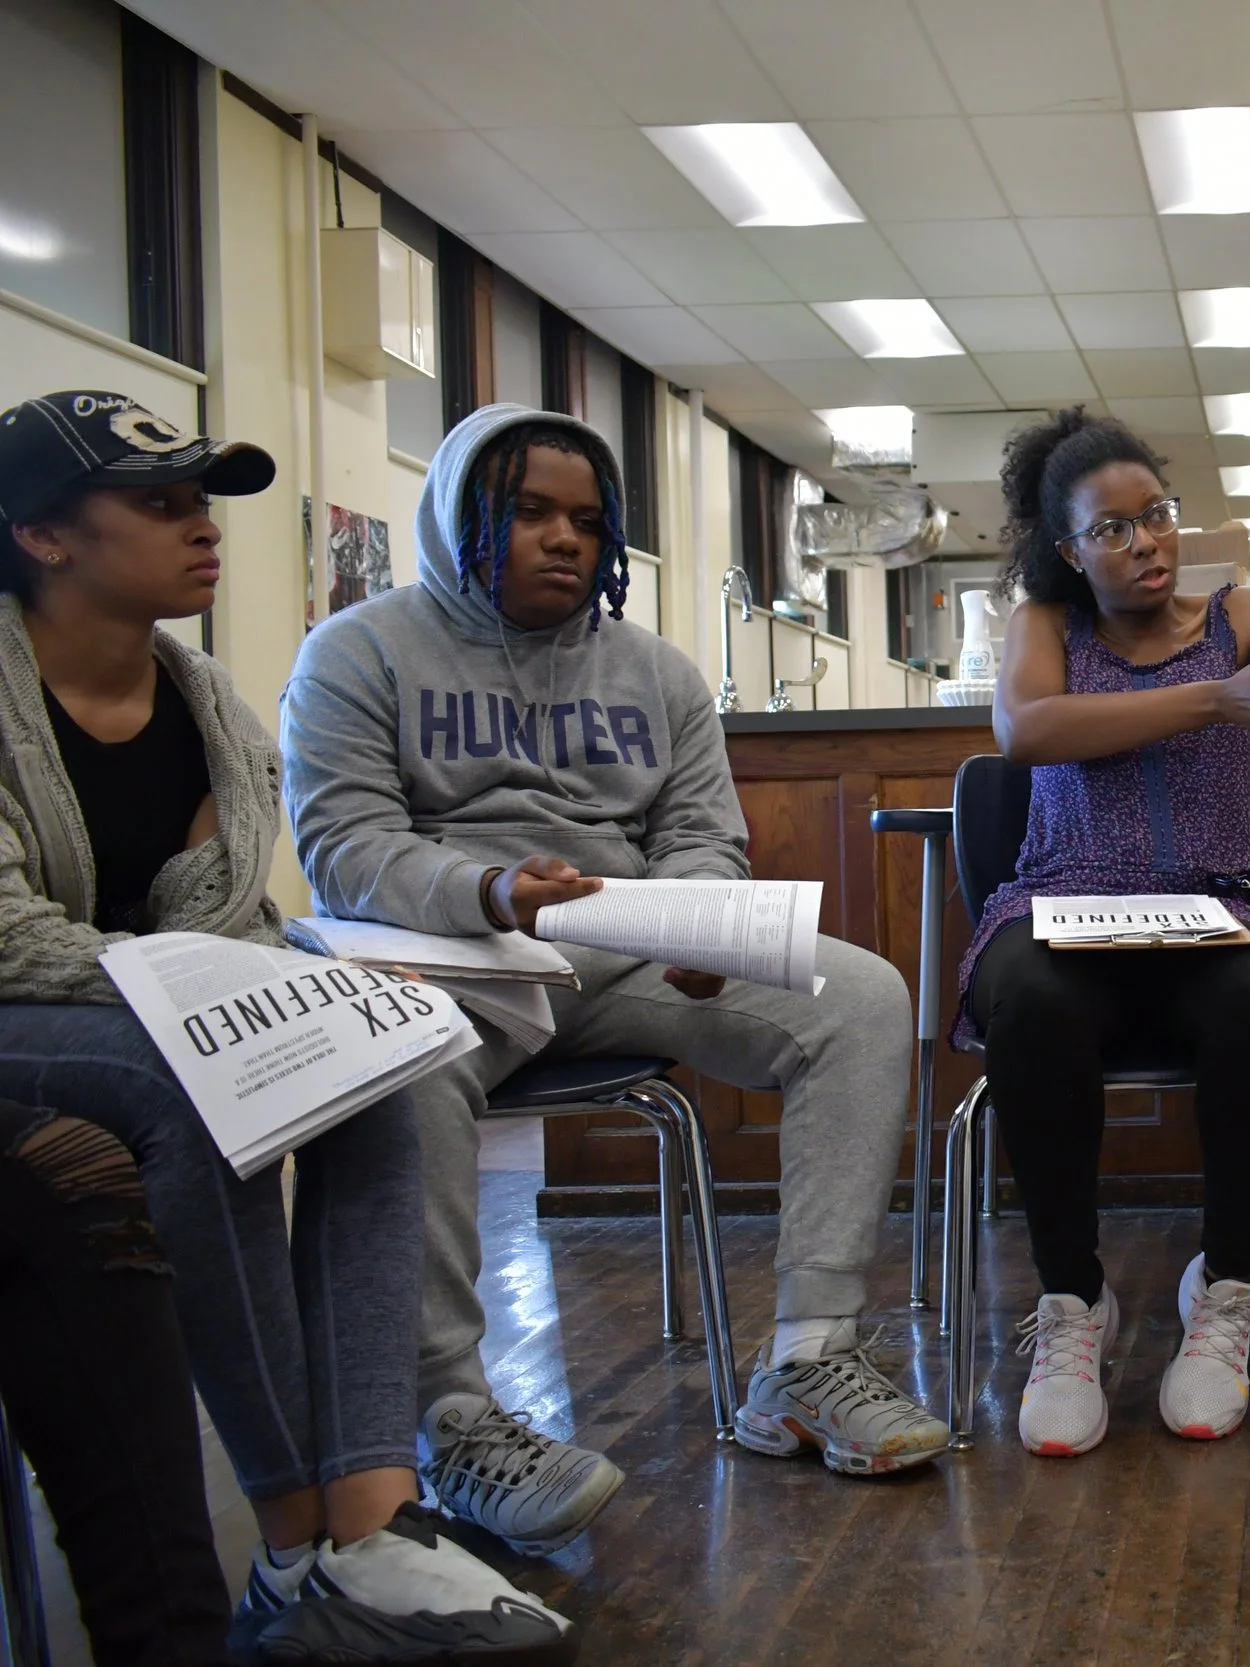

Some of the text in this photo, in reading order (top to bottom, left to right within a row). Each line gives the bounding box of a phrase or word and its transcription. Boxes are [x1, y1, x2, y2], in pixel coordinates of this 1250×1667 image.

[420, 688, 658, 769] HUNTER
[1052, 913, 1207, 924] REDEFINED
[350, 985, 434, 1038] SEX
